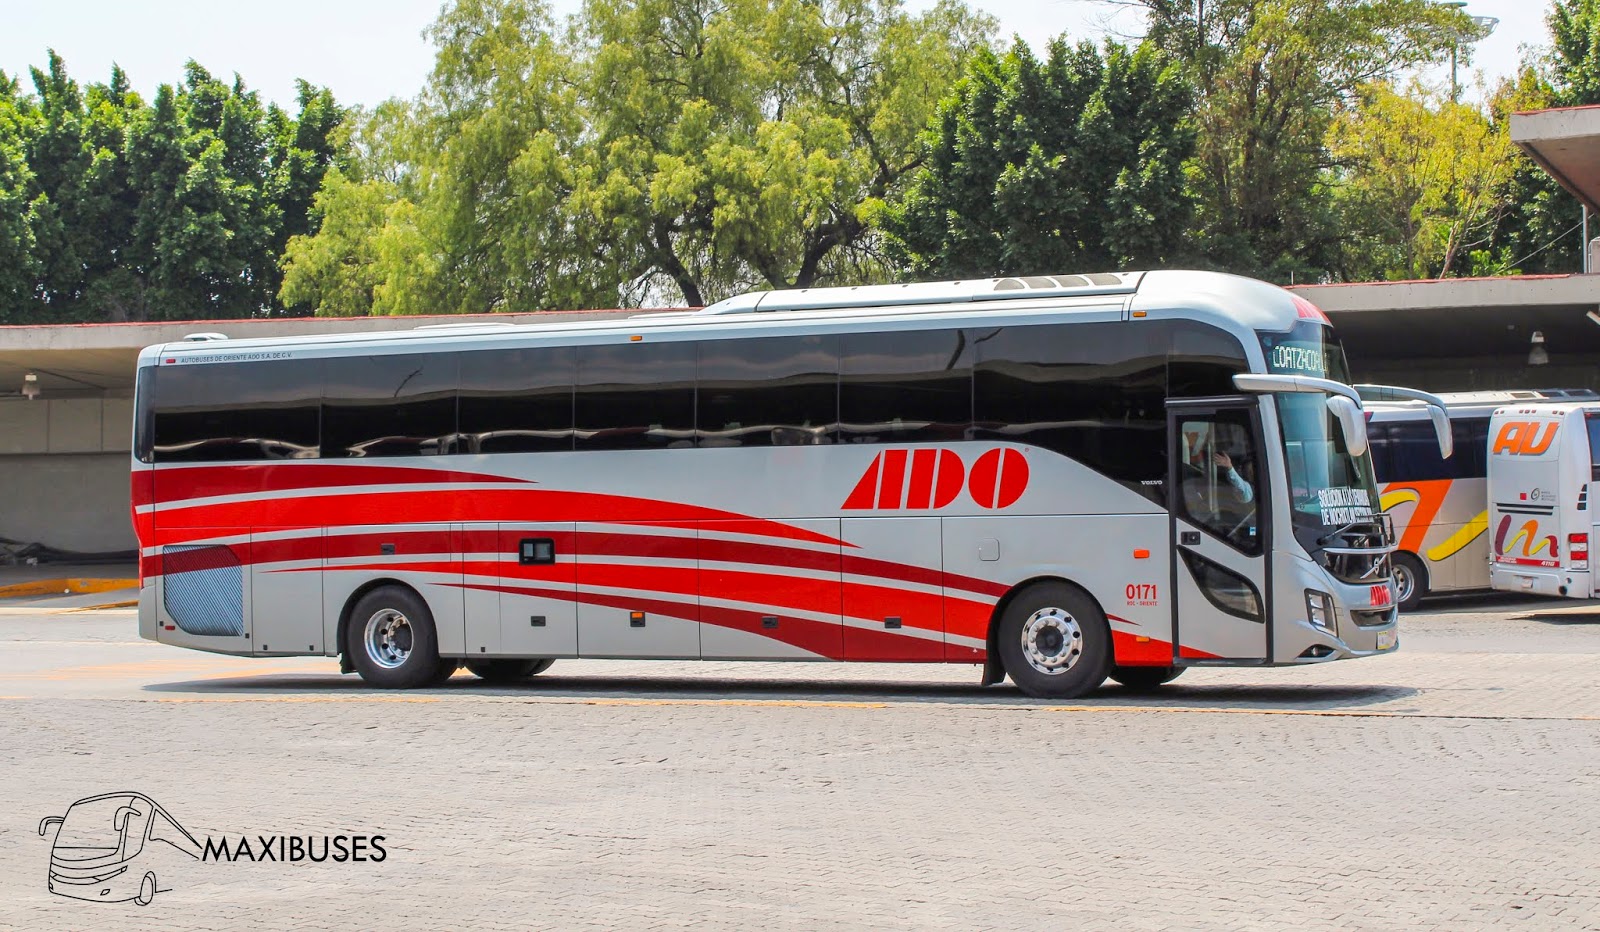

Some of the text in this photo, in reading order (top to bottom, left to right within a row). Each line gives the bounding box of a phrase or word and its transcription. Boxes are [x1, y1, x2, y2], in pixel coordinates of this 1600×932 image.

[1492, 421, 1559, 456] AU
[840, 448, 1030, 510] ADO
[1126, 583, 1156, 600] 0171
